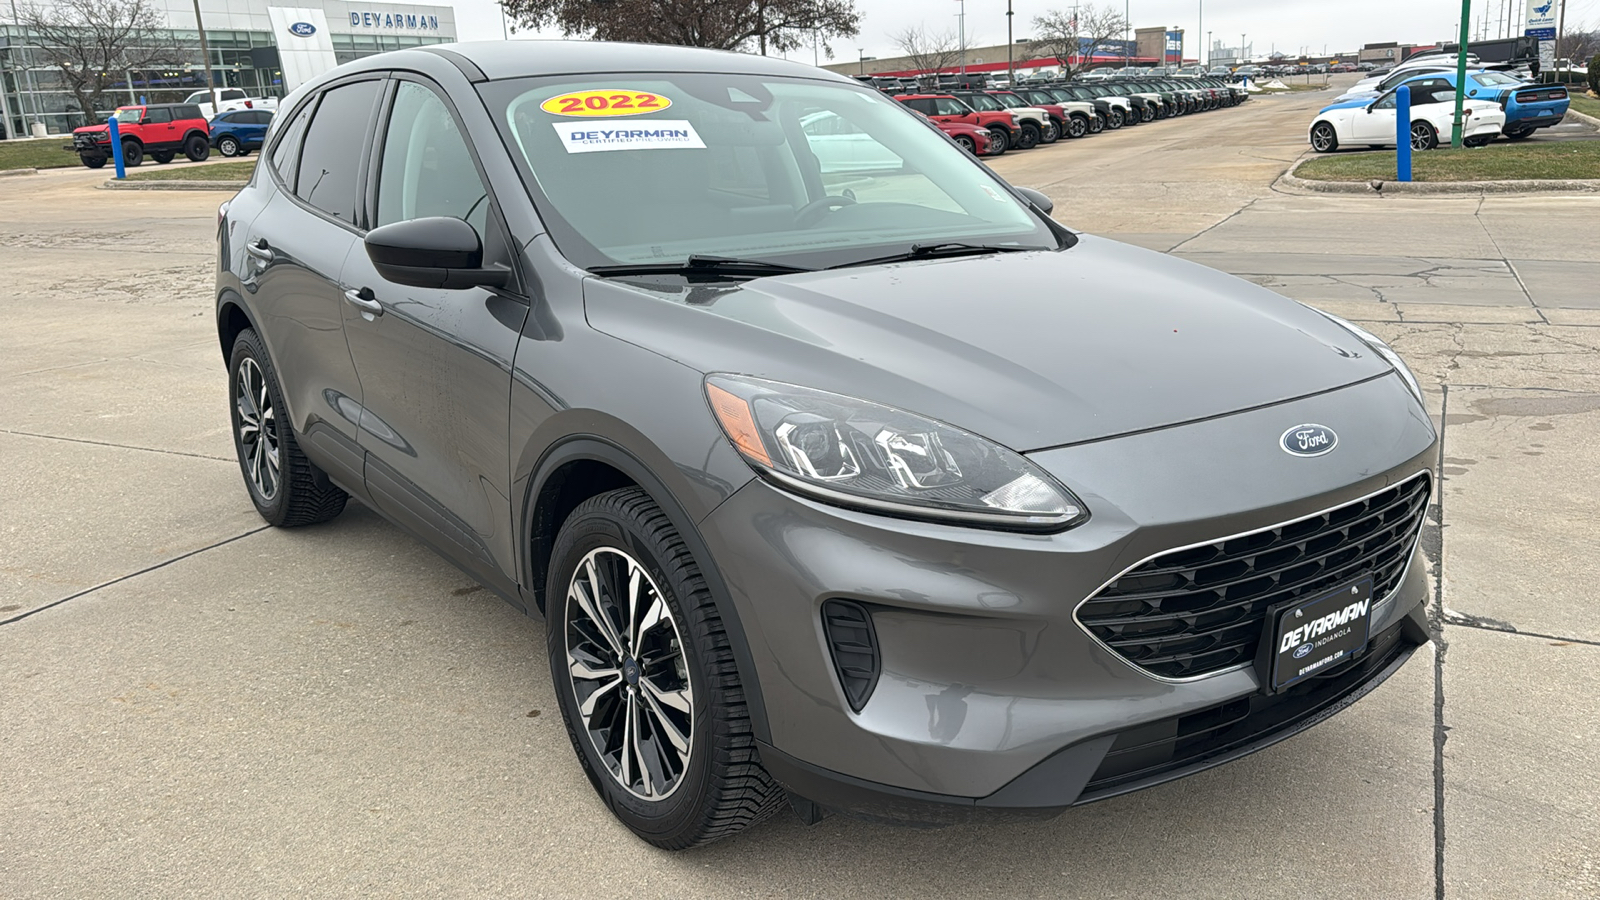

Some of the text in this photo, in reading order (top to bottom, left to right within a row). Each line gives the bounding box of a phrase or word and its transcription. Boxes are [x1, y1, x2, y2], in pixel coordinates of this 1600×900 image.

[351, 12, 439, 29] DEYARMAN
[559, 94, 660, 112] 2022
[571, 130, 688, 140] DEYARMAN
[1296, 429, 1328, 450] Ford
[1279, 598, 1370, 654] DEYARMAN
[1315, 626, 1352, 649] INDIANOLA
[1299, 650, 1344, 676] DEYARMANFORD.COM
